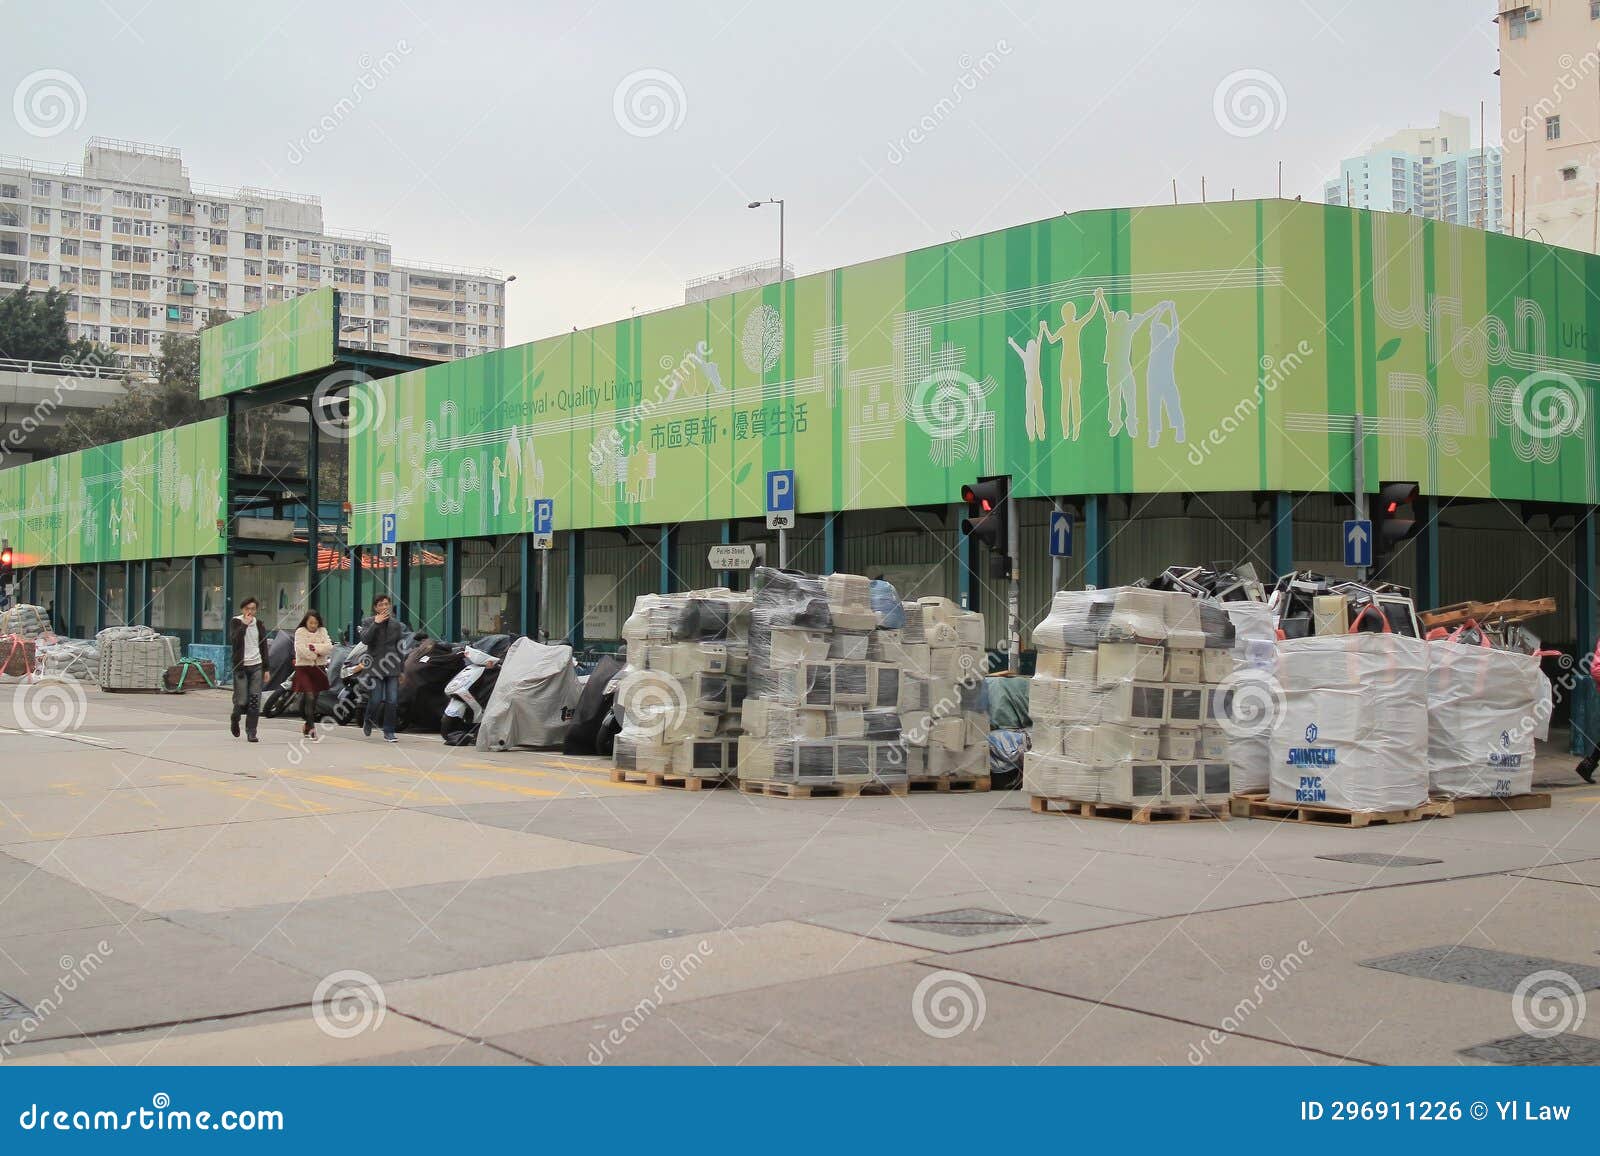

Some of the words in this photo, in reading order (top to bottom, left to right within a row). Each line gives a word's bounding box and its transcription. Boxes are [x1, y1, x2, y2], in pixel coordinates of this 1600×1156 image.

[503, 392, 547, 421] Renewal
[557, 384, 601, 410] Quality
[604, 379, 643, 402] Living
[772, 474, 790, 508] P
[538, 503, 550, 531] P
[384, 515, 394, 541] P
[1286, 748, 1337, 764] SHINTECH
[1300, 776, 1321, 789] PVC
[1496, 779, 1511, 791] PVC
[1295, 789, 1326, 802] RESIN
